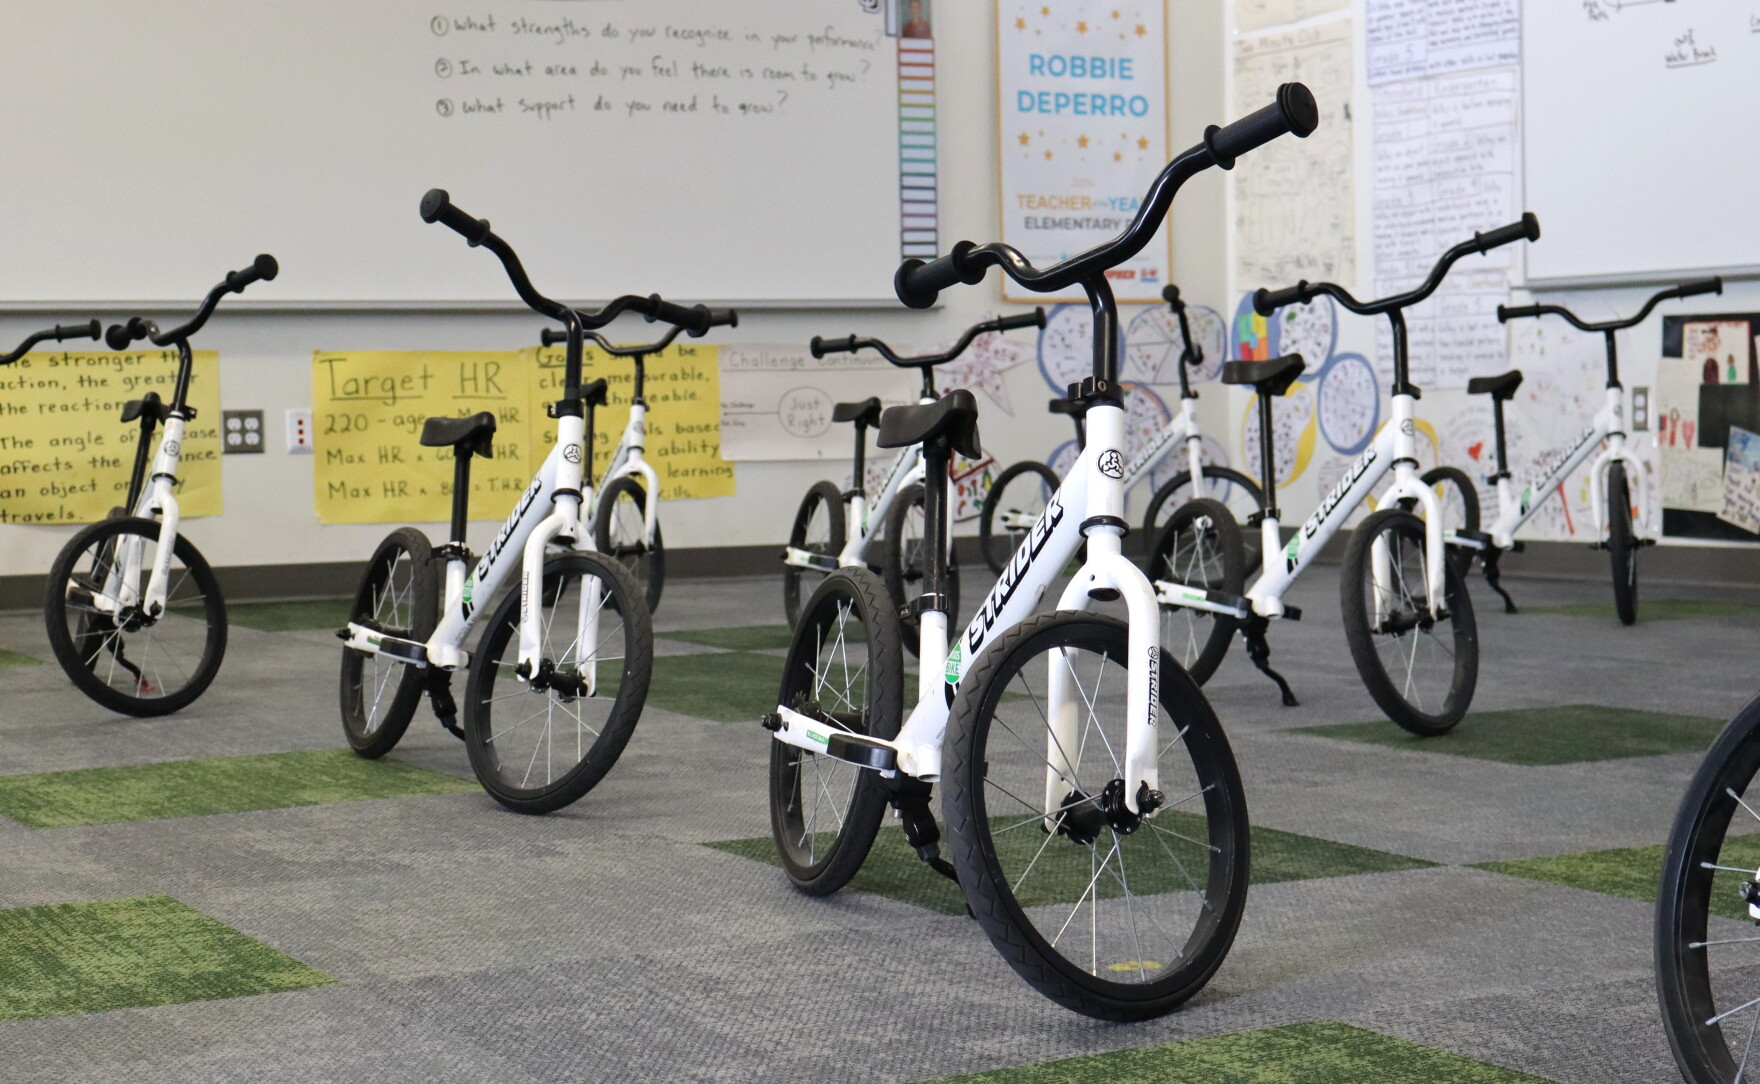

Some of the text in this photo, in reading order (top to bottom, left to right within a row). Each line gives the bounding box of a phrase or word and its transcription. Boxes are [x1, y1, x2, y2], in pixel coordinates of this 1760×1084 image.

[511, 17, 590, 45] strengths
[602, 23, 619, 38] do
[629, 27, 655, 44] you
[665, 25, 731, 47] recognize
[746, 31, 760, 43] in
[772, 33, 797, 50] your
[459, 59, 481, 75] In
[493, 60, 533, 77] what
[545, 65, 577, 76] area
[590, 60, 608, 77] do
[620, 66, 643, 80] you
[691, 61, 731, 79] there
[739, 68, 754, 79] is
[762, 67, 796, 82] room
[801, 63, 817, 82] to
[1029, 53, 1134, 80] ROBBIE
[593, 95, 612, 111] do
[625, 103, 651, 117] you
[662, 95, 697, 113] need
[712, 94, 730, 114] to
[1017, 90, 1149, 117] DEPERRO
[1016, 194, 1092, 210] TEACHER
[1024, 217, 1121, 230] ELEMENTARY
[49, 352, 146, 372] stronger
[729, 352, 805, 371] Challenge
[76, 375, 109, 389] the
[122, 371, 198, 392] greatr
[318, 357, 503, 407] Target HR
[607, 367, 710, 383] mesurable.
[0, 402, 28, 416] the
[791, 398, 820, 412] Just
[323, 413, 368, 435] 220
[499, 407, 519, 423] HR
[787, 415, 826, 434] Right
[0, 436, 34, 450] The
[49, 431, 104, 452] angle
[120, 428, 137, 443] of
[658, 440, 720, 458] ability
[326, 447, 365, 465] Max
[378, 445, 404, 463] HR
[0, 456, 121, 475] affects the
[667, 462, 733, 478] learning
[0, 488, 26, 499] an
[40, 478, 97, 499] object
[328, 480, 371, 499] Max
[382, 480, 408, 498] HR
[1305, 441, 1377, 540] STRIDER
[0, 505, 83, 523] travels.
[479, 471, 542, 582] STRIDER
[968, 488, 1064, 655] STRIDER
[945, 662, 959, 675] BIKE
[1148, 659, 1159, 729] STRIDER
